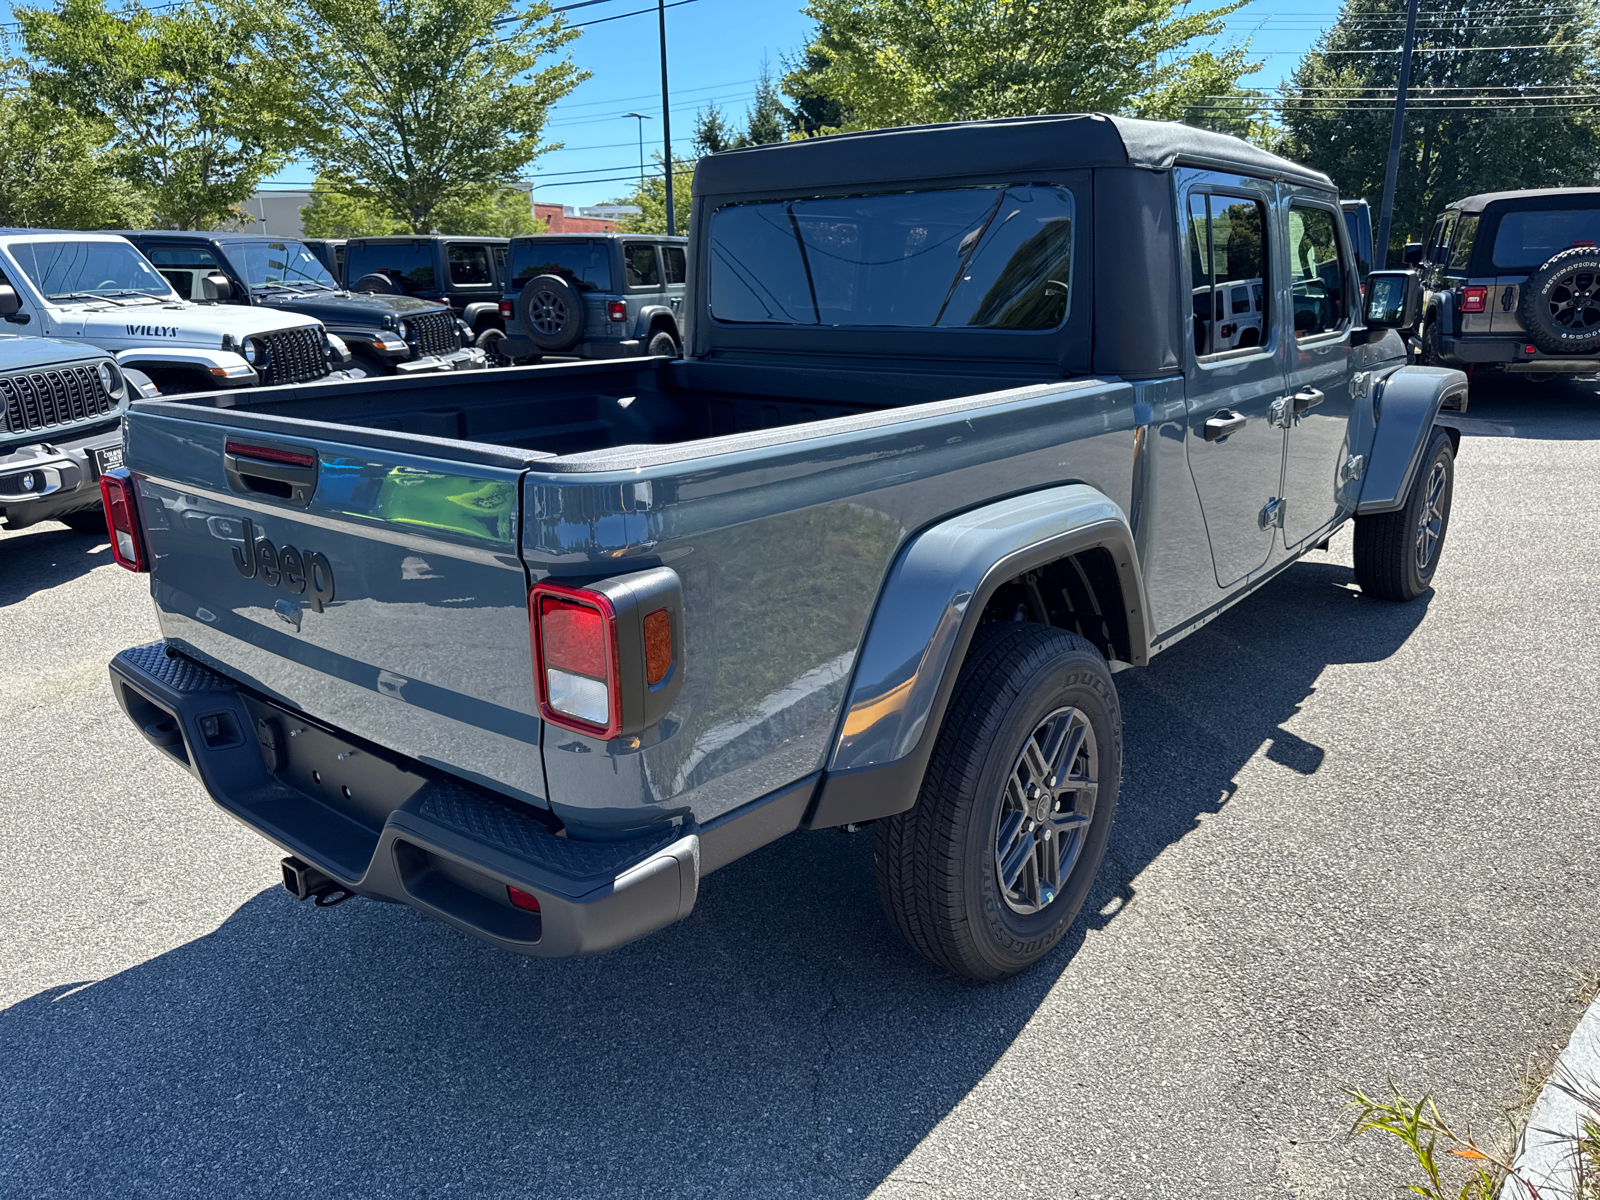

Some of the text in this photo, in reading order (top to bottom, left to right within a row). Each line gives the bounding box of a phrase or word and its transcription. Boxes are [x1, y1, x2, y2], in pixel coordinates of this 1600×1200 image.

[126, 324, 179, 337] WILLYS
[231, 517, 335, 614] Jeep
[981, 850, 1069, 955] BRIDGESTONE
